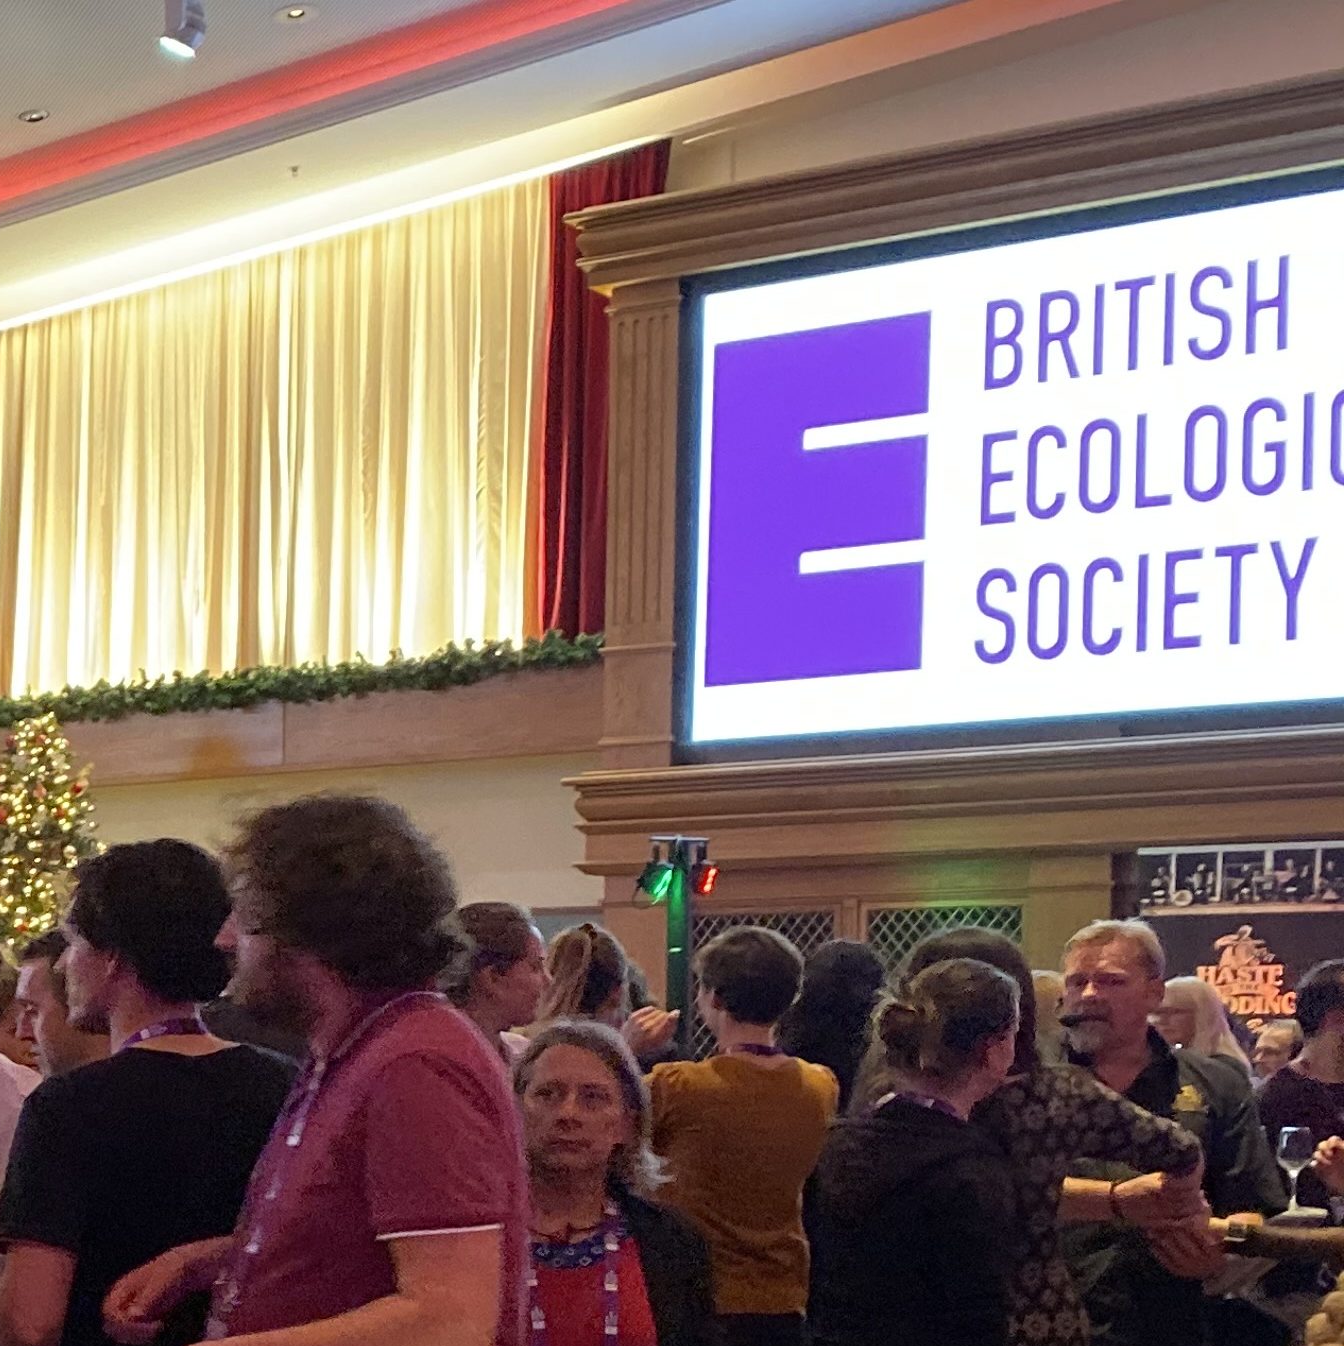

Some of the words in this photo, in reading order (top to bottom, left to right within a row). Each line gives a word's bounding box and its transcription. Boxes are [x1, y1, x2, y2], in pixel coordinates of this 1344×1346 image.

[984, 254, 1291, 391] BRITISH
[973, 536, 1318, 665] SOCIETY
[1196, 964, 1284, 986] HASTE
